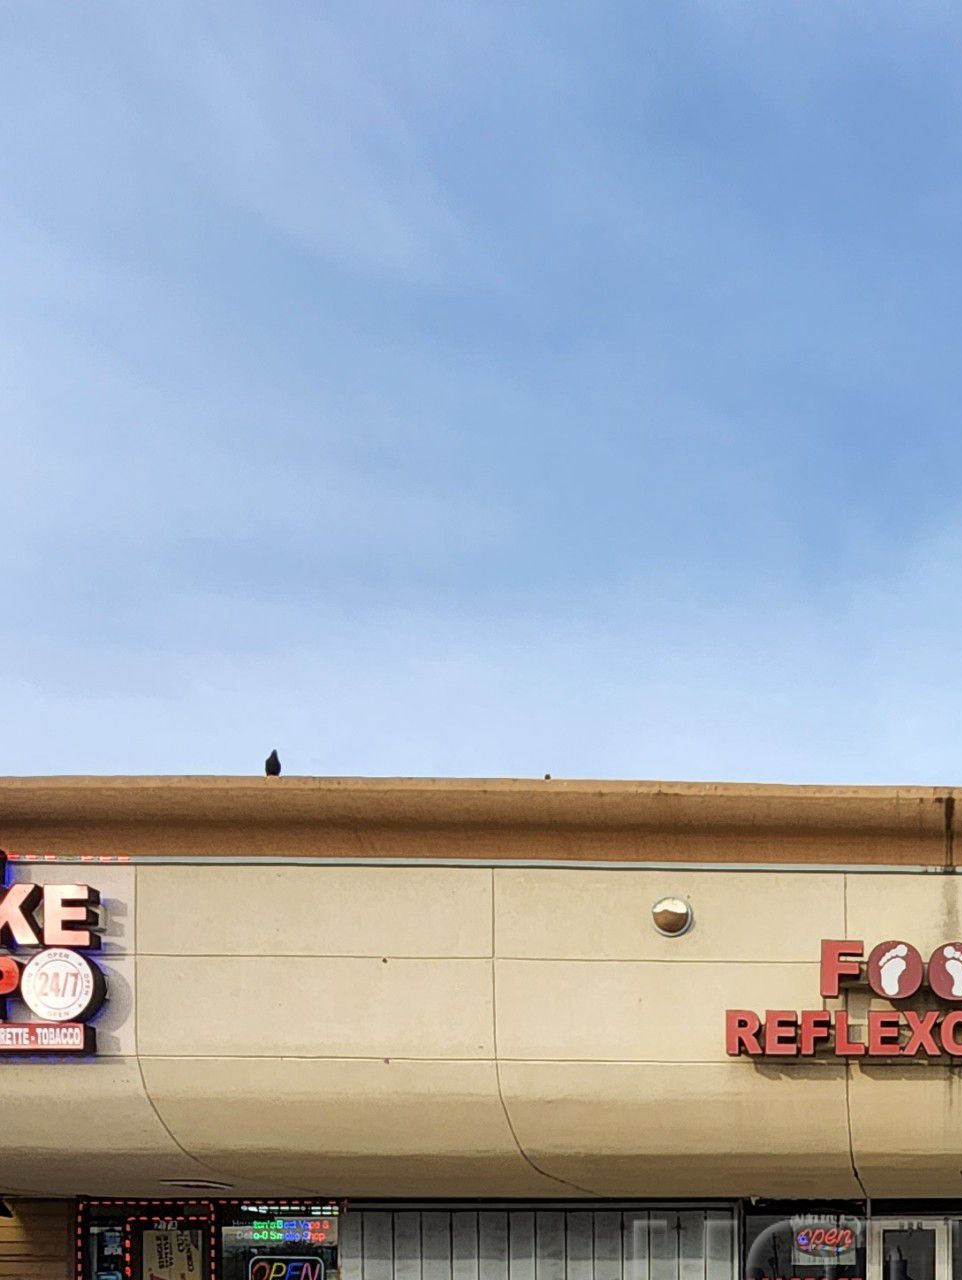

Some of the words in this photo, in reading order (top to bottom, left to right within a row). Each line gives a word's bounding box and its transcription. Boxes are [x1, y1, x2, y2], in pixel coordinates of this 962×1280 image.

[47, 952, 70, 960] OPEN
[38, 971, 79, 998] 24/7
[36, 1028, 80, 1045] TOBACCO
[797, 1227, 852, 1245] open
